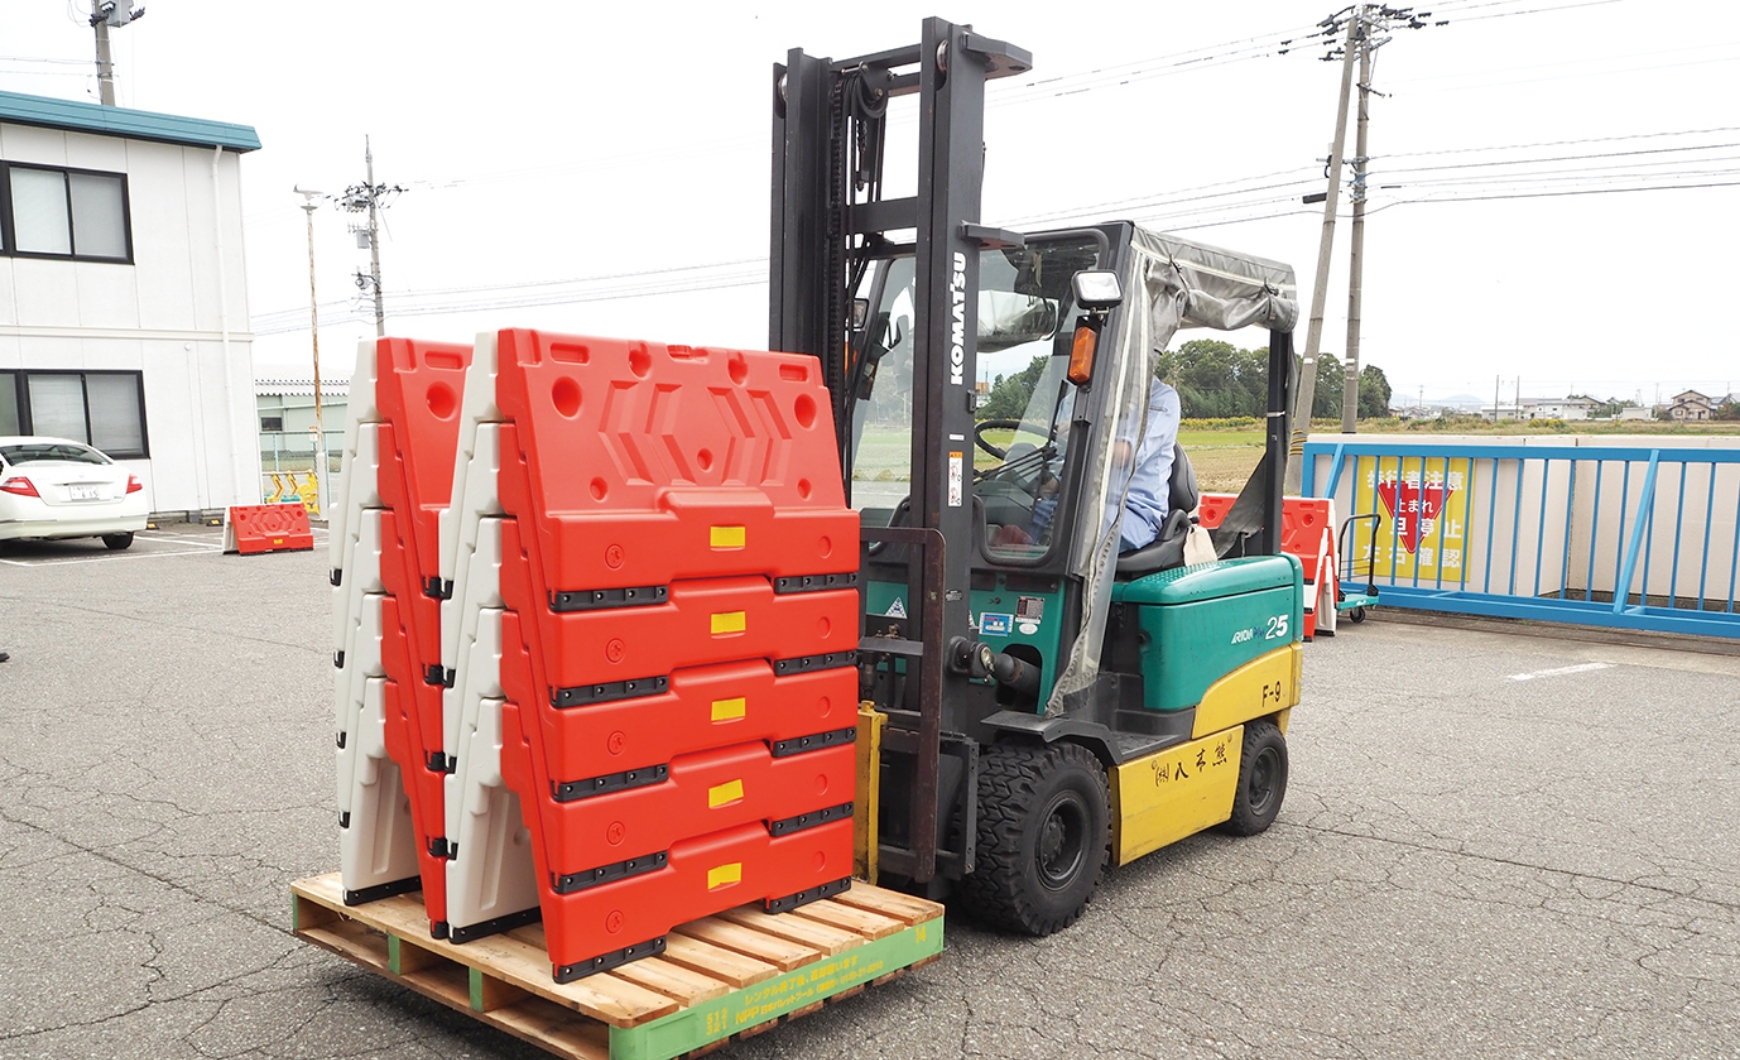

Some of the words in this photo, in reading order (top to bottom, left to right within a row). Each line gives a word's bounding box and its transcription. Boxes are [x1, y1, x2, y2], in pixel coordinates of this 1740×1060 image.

[951, 252, 967, 385] KOMATSU
[1367, 469, 1464, 490] 歩行者注意
[1393, 499, 1434, 514] 止まれ
[1364, 517, 1462, 538] 一旦停止
[1363, 544, 1461, 568] 左右確認
[1265, 614, 1289, 640] 25
[1262, 681, 1281, 707] F-9
[735, 1005, 760, 1025] NPP
